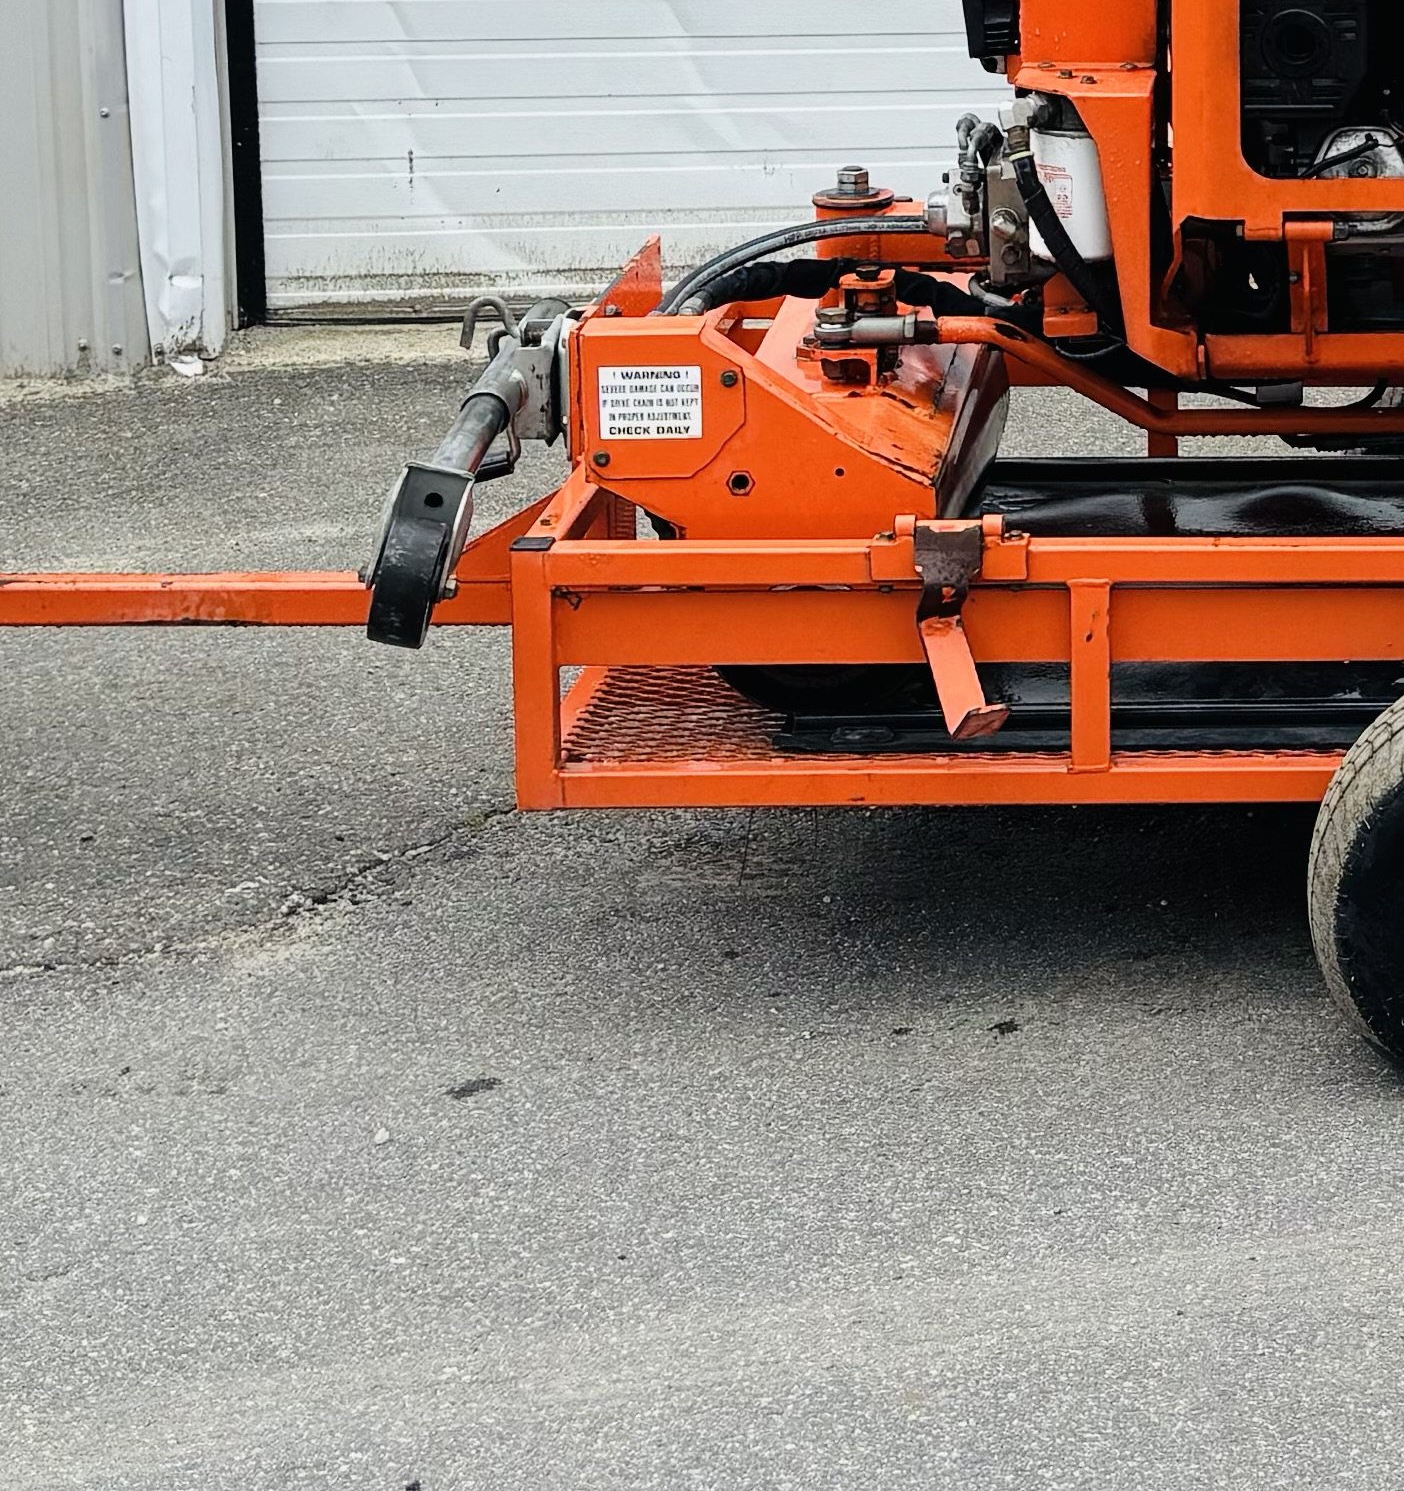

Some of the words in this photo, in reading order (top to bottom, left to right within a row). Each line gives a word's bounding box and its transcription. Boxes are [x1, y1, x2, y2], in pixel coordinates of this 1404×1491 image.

[621, 371, 681, 380] WARNING
[601, 384, 626, 394] SEVERE
[629, 384, 657, 394] DAMAGE
[660, 384, 674, 393] CAN
[677, 384, 699, 393] OCCUR
[611, 398, 630, 408] DRIVE
[633, 398, 654, 407] CHAIN
[656, 398, 663, 407] IS
[666, 398, 678, 407] NOT
[681, 398, 699, 407] KEPT
[609, 412, 616, 421] IN
[618, 412, 644, 421] PROPER
[609, 426, 650, 435] CHECK
[656, 426, 690, 434] DAILY
